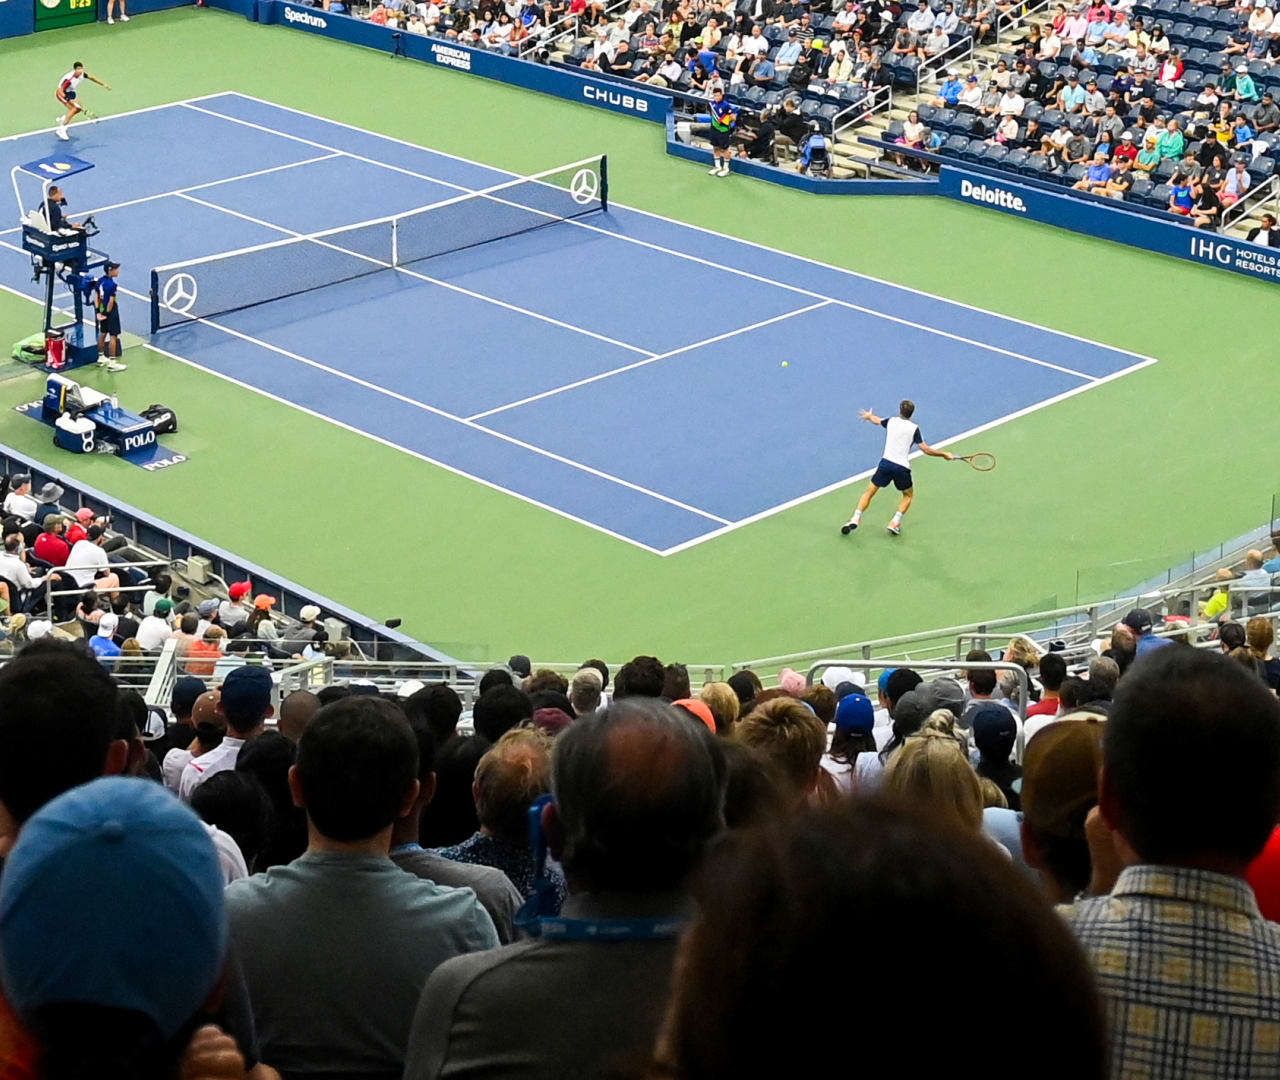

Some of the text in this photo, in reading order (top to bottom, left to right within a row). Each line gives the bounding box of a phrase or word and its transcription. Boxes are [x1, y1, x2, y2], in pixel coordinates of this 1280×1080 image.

[284, 6, 326, 29] Spectrum
[431, 43, 471, 60] AMERICAN
[436, 53, 471, 71] EXPRESS
[583, 85, 648, 113] CHUBB
[961, 179, 1027, 212] Deloitte.
[1190, 236, 1233, 264] IHG
[1236, 248, 1276, 266] HOTELS
[124, 430, 156, 452] POLO
[143, 454, 188, 472] POLO
